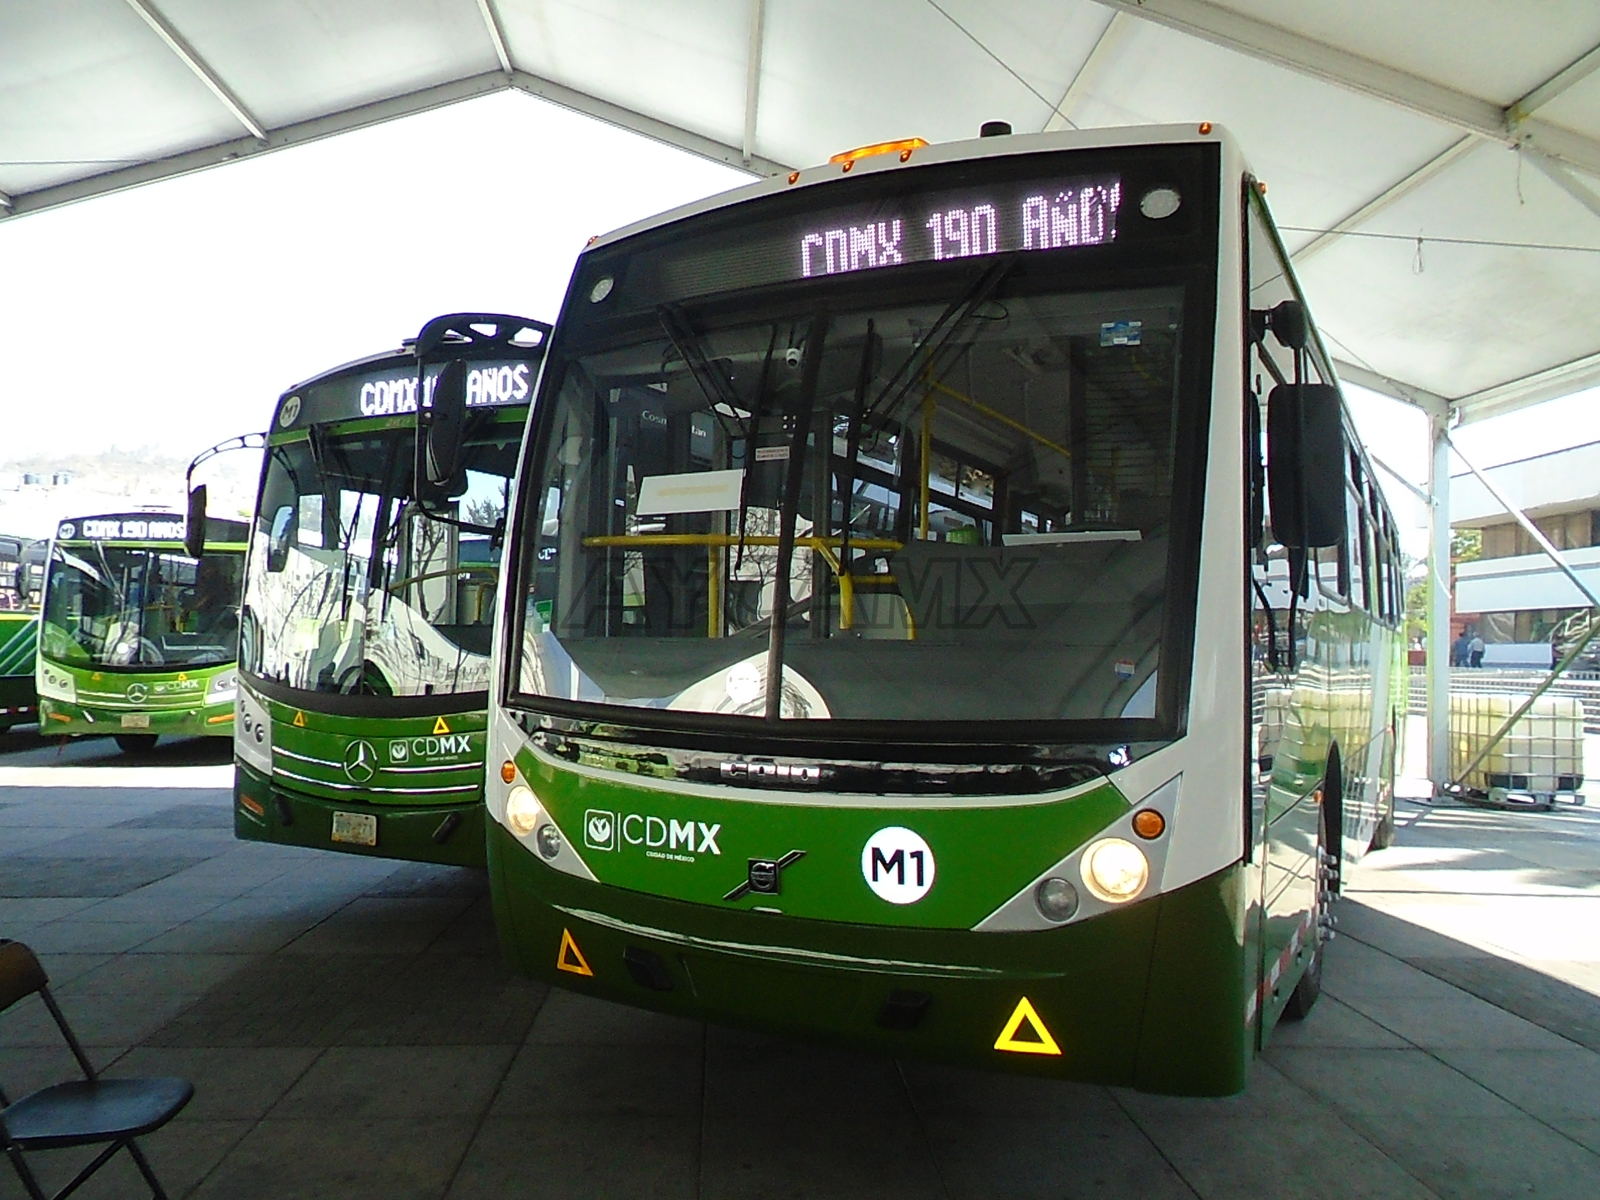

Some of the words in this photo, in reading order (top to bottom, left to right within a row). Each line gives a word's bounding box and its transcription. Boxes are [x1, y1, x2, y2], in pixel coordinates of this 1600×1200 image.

[926, 204, 997, 261] 190
[360, 376, 418, 416] CDMX
[465, 364, 529, 405] AÑOS
[281, 403, 298, 420] M1
[167, 679, 199, 690] CDMX
[412, 735, 471, 756] CDMX
[623, 814, 721, 855] CDMX
[871, 846, 924, 887] M1
